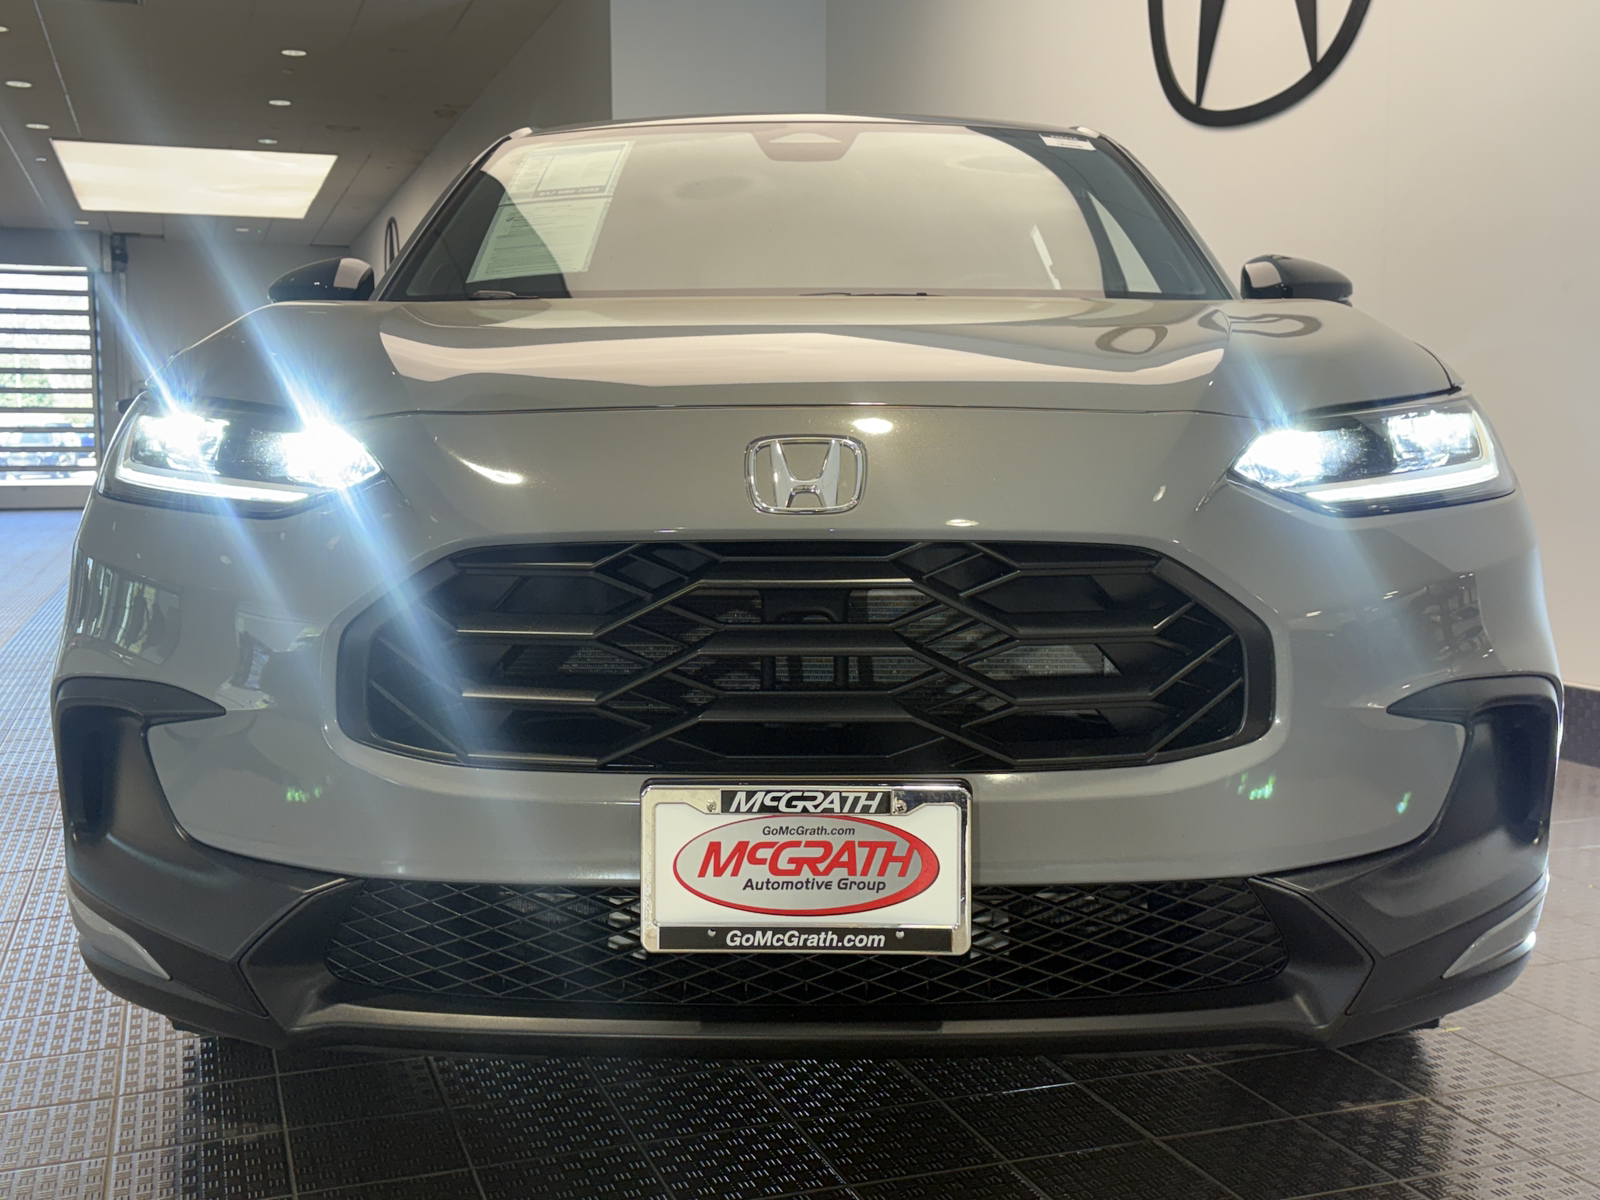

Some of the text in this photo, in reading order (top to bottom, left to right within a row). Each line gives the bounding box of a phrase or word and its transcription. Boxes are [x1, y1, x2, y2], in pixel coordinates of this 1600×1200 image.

[763, 826, 855, 836] GoMcGrath.com
[743, 878, 886, 893] Automotive Group
[726, 930, 885, 947] GoMcGrath.com
